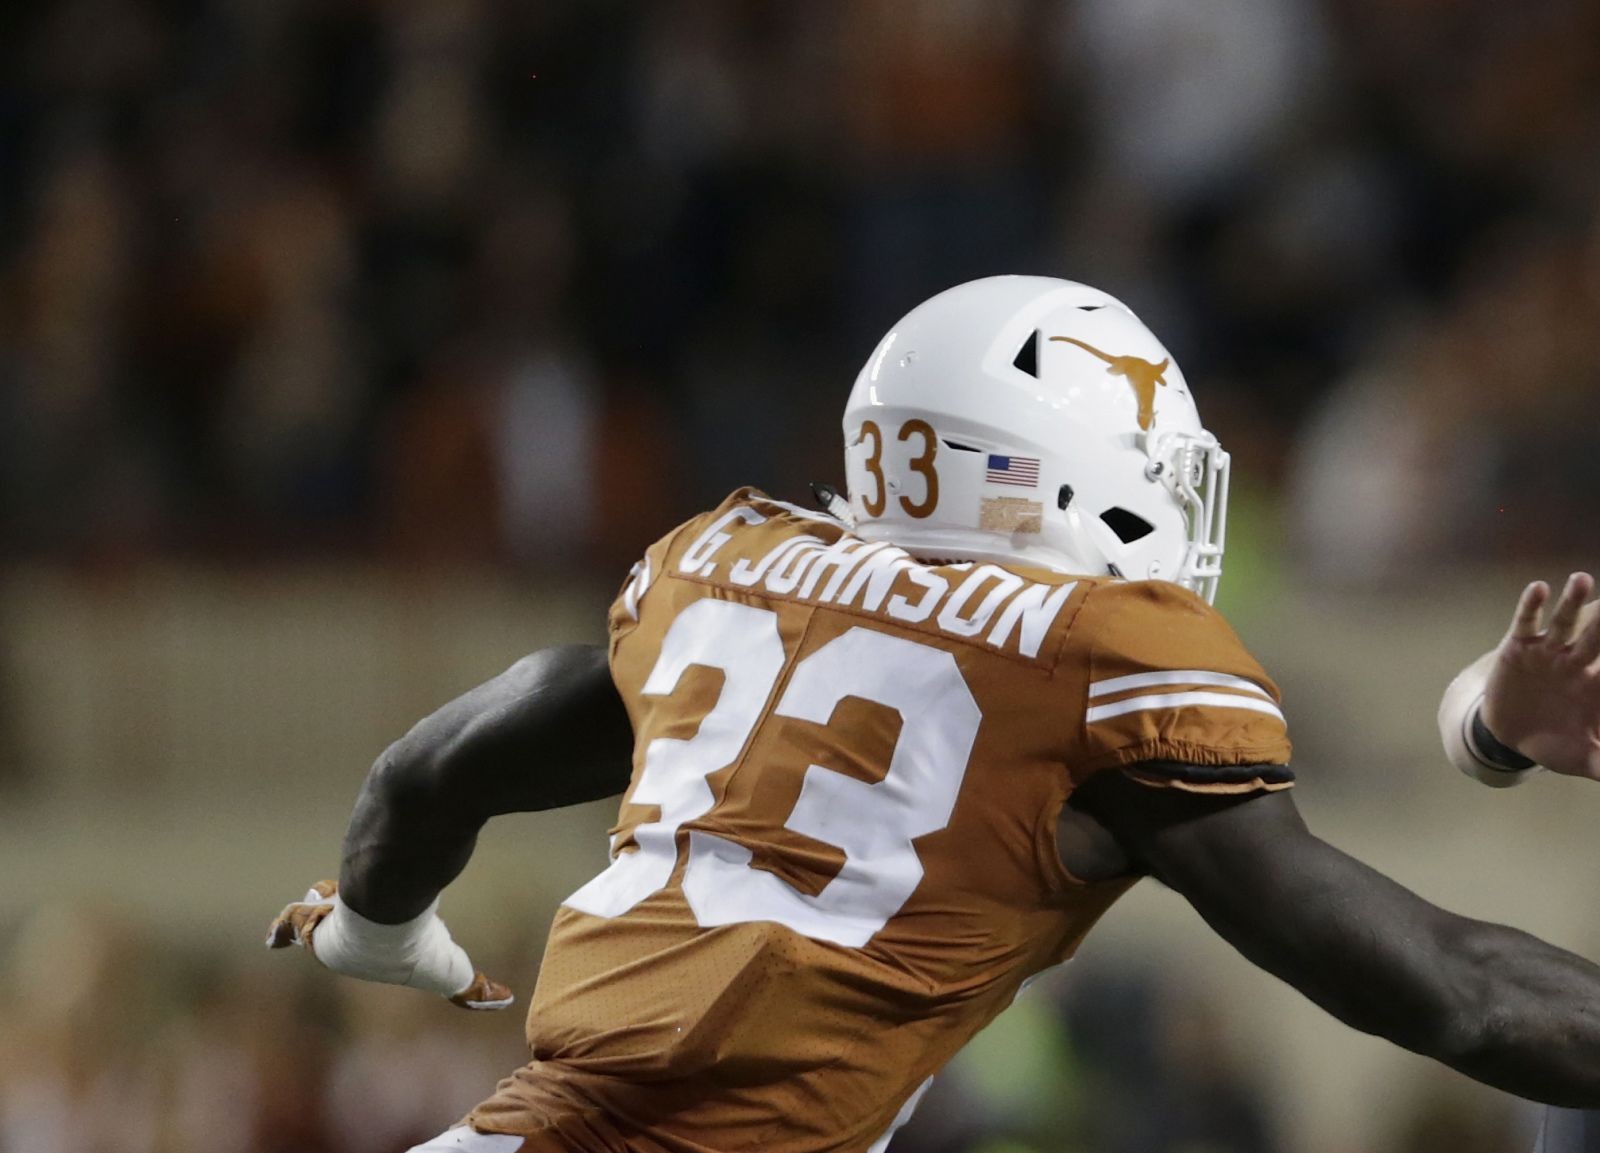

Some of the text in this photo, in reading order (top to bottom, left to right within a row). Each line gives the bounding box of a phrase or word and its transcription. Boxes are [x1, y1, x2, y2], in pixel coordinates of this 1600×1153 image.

[859, 418, 940, 519] 33
[679, 506, 1080, 659] G. JOHNSON
[563, 598, 982, 948] 33
